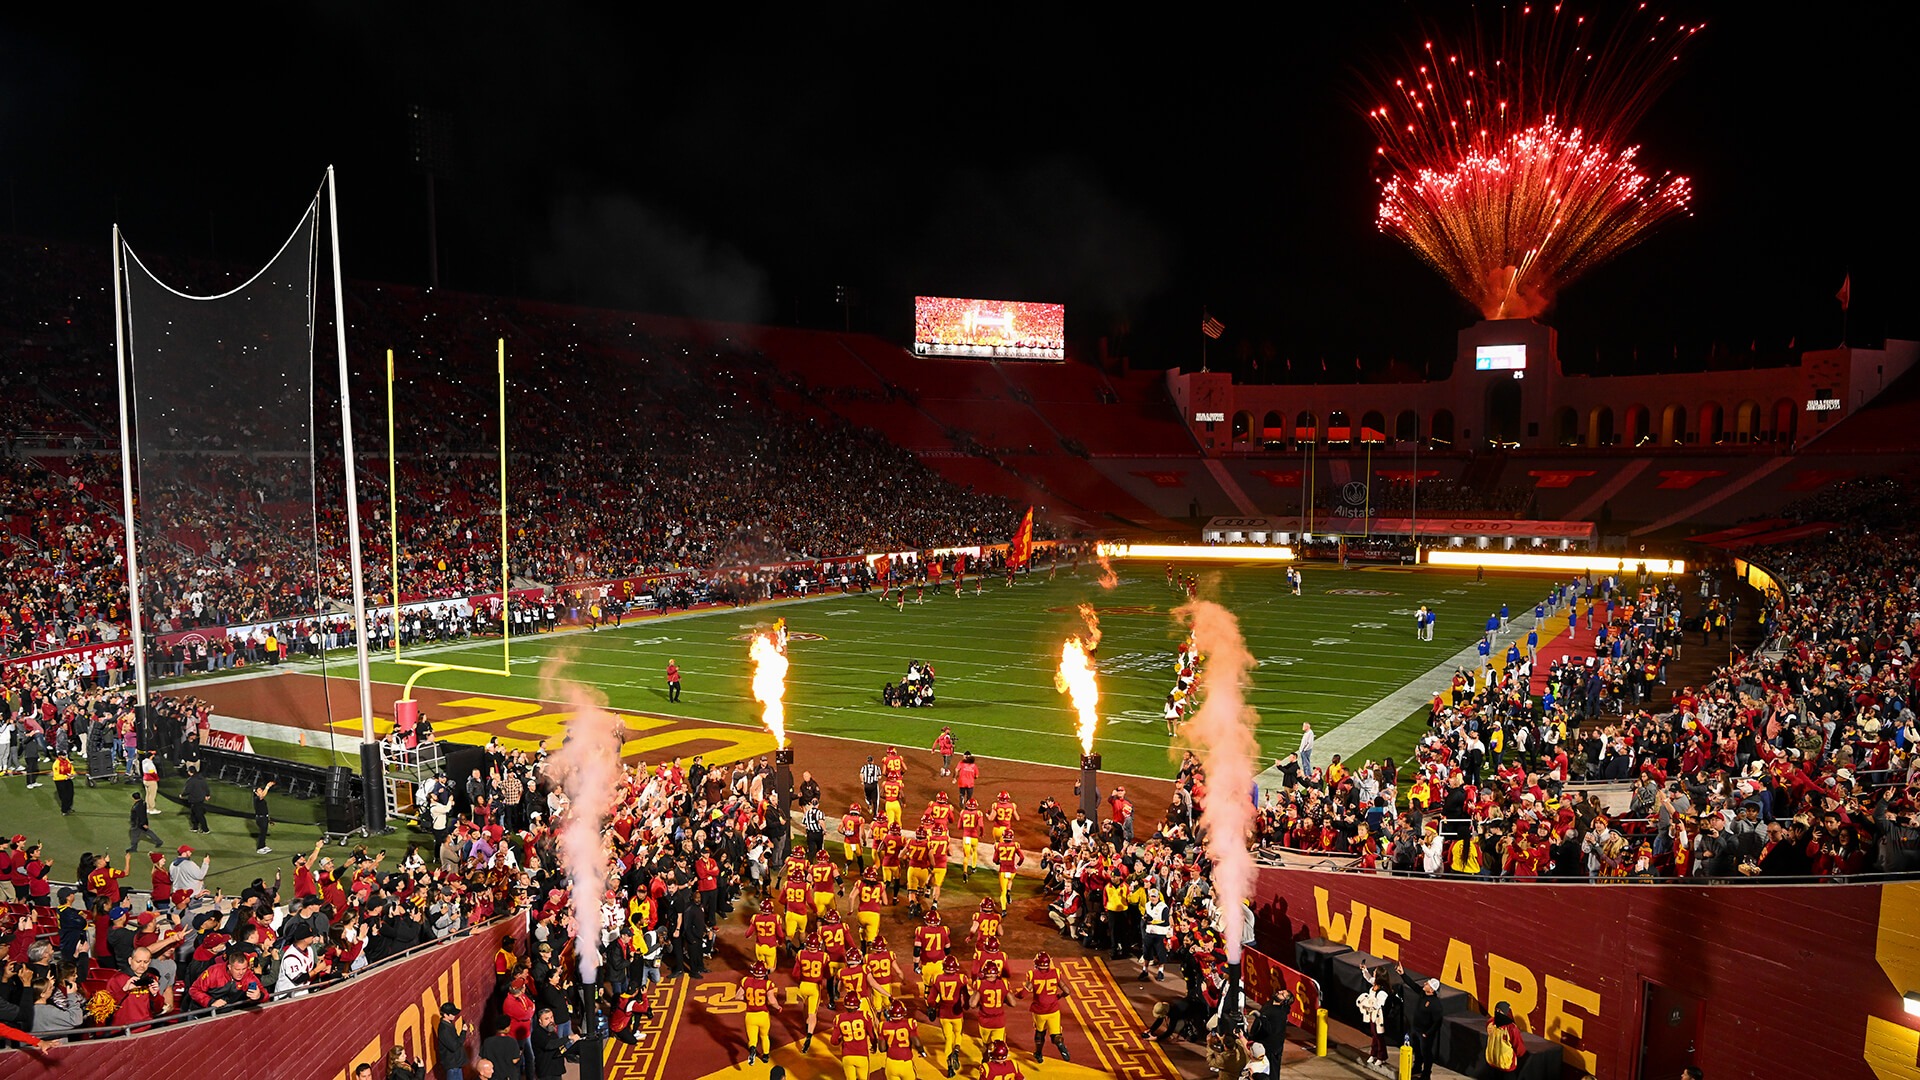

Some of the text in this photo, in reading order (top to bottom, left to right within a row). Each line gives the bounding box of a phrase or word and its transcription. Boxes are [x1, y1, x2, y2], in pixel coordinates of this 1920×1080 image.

[1334, 504, 1376, 519] Allstate
[887, 755, 901, 771] 49
[884, 784, 899, 797] 53
[932, 805, 949, 819] 97
[997, 807, 1012, 821] 93
[847, 820, 855, 832] 9
[963, 813, 975, 828] 21
[873, 827, 889, 841] 46
[888, 840, 897, 855] 2
[909, 845, 927, 861] 77
[931, 840, 948, 855] 77
[999, 846, 1016, 862] 27
[93, 874, 106, 887] 15
[813, 867, 832, 883] 57
[786, 888, 805, 903] 89
[861, 887, 881, 903] 64
[755, 921, 776, 937] 53
[980, 919, 999, 937] 48
[823, 929, 845, 947] 24
[924, 933, 942, 951] 71
[801, 960, 822, 978] 28
[870, 958, 891, 978] 29
[841, 973, 864, 994] 57
[939, 981, 957, 1001] 17
[1034, 978, 1058, 996] 75
[745, 986, 766, 1006] 46
[983, 989, 1002, 1008] 31
[1440, 938, 1600, 1077] ARE
[839, 1019, 865, 1042] 98
[883, 1027, 910, 1048] 79
